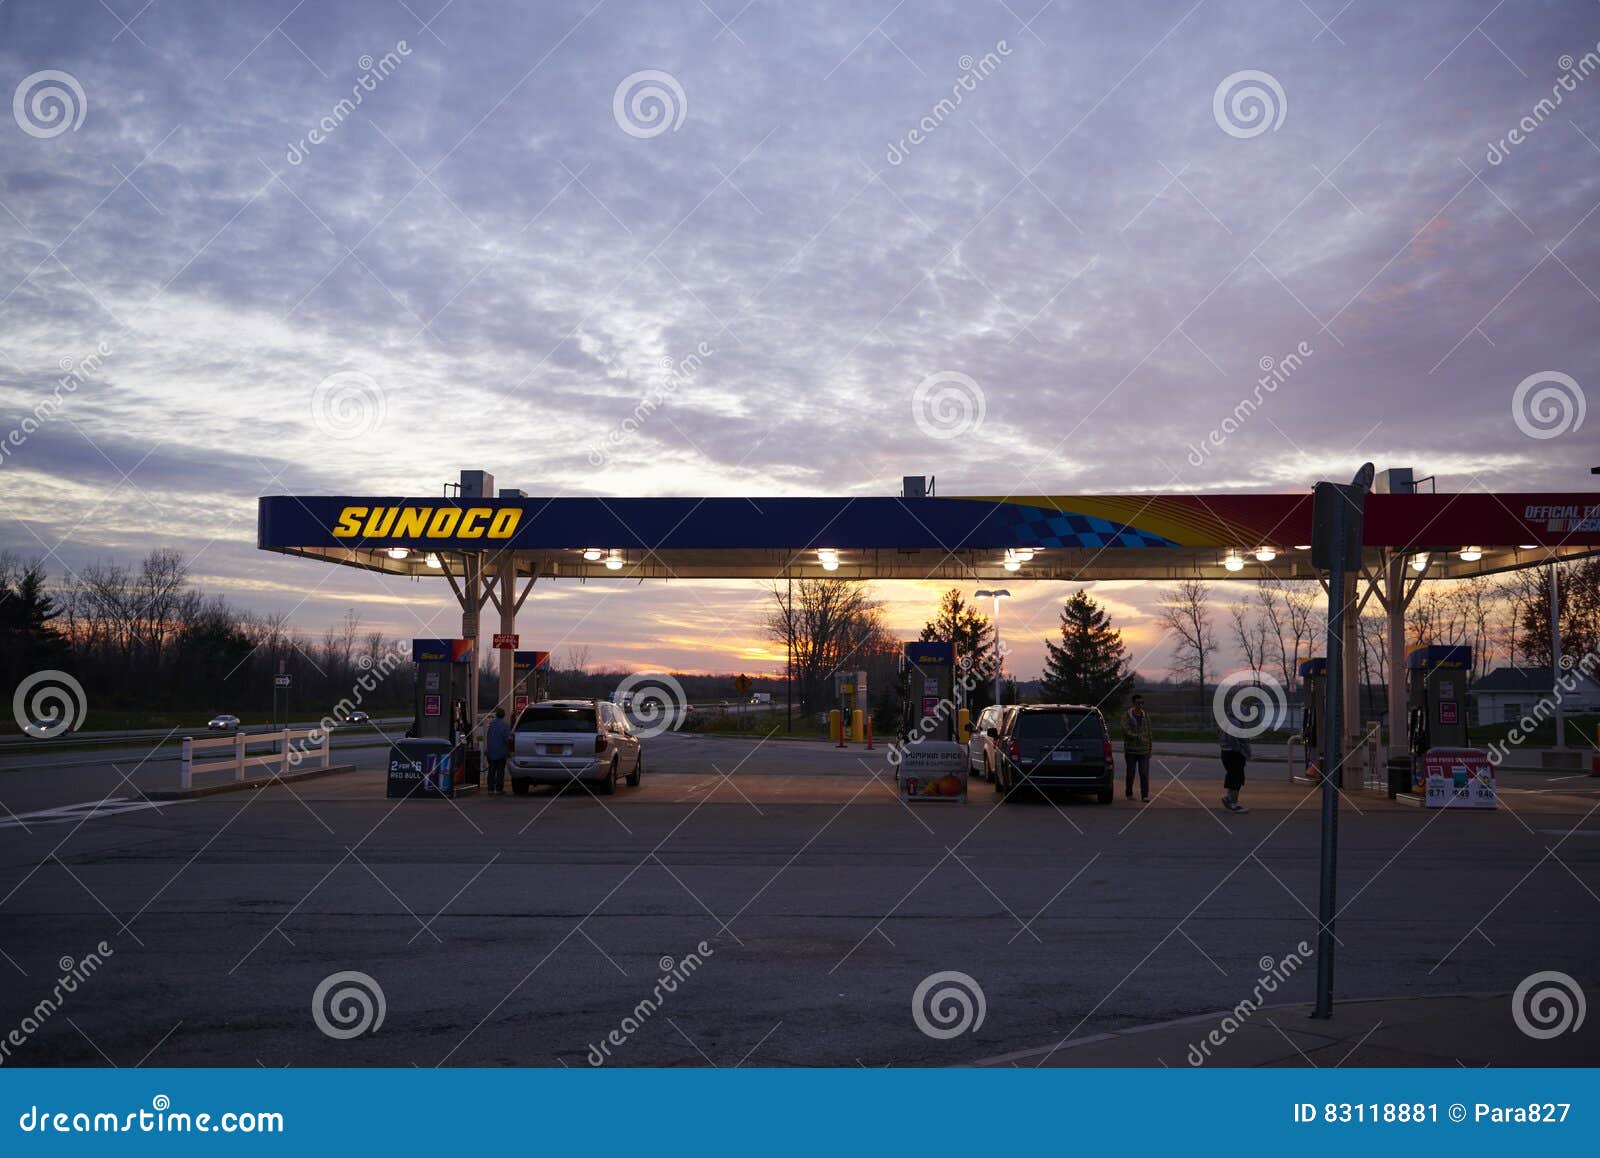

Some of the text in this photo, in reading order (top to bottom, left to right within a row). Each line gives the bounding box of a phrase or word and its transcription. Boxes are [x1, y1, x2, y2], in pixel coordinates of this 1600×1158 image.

[1524, 504, 1580, 519] OFFICIAL
[332, 506, 523, 539] SUNOCO
[391, 760, 398, 772] 2
[390, 771, 420, 779] RED BULL
